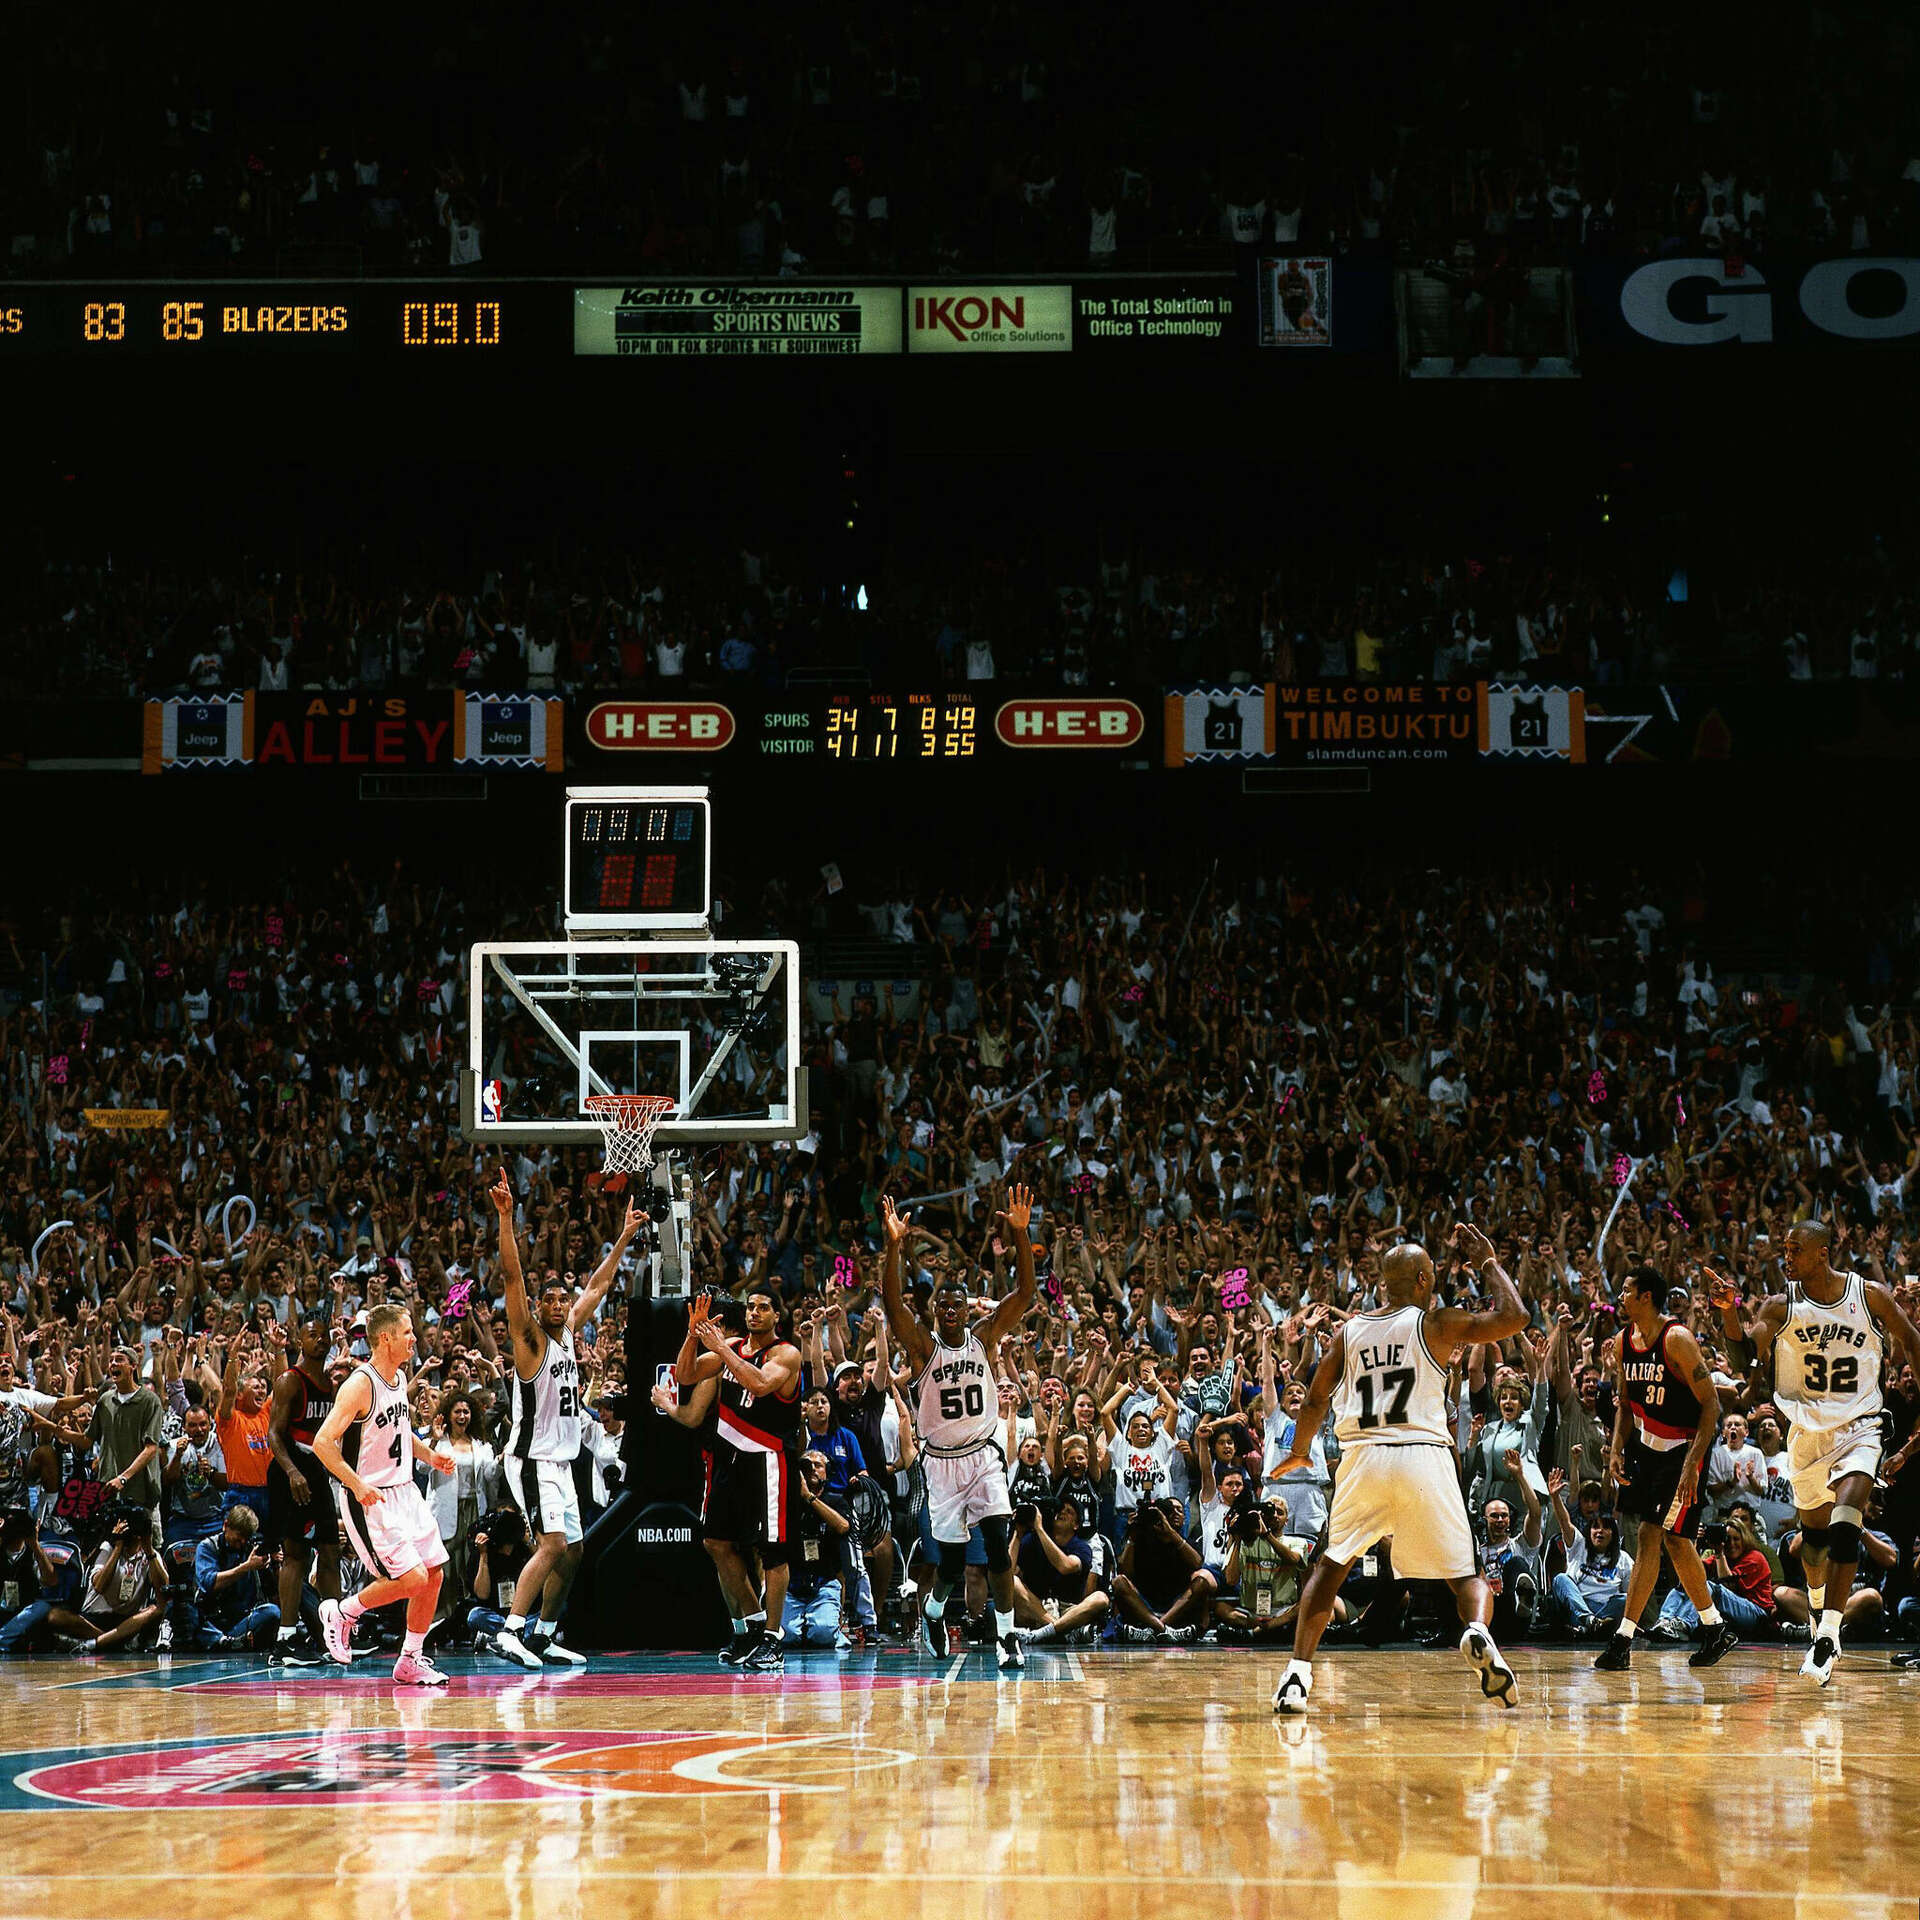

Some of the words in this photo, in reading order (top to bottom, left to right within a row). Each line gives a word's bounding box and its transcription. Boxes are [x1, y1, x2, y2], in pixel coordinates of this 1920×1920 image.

[621, 288, 694, 305] Keith
[700, 288, 855, 305] Olbermann
[1079, 299, 1106, 315] The
[1110, 298, 1150, 315] Total
[1153, 297, 1215, 315] Solution
[1218, 296, 1233, 314] in
[1621, 257, 1920, 345] GO
[0, 308, 23, 333] S
[85, 302, 125, 341] 83
[163, 302, 204, 341] 85
[223, 306, 348, 333] BLAZERS
[404, 302, 499, 345] 09.0
[712, 311, 783, 333] SPORTS
[787, 311, 841, 333] NEWS
[915, 296, 1025, 342] IKON
[1089, 319, 1133, 336] Office
[1137, 318, 1223, 337] Technology
[656, 339, 673, 353] ON
[678, 339, 700, 353] FOX
[705, 339, 754, 353] SPORTS
[759, 339, 782, 353] NET
[787, 338, 861, 353] SOUTHWEST
[971, 330, 1006, 342] Office
[1009, 330, 1065, 342] Solutions
[305, 696, 408, 717] AJ'S
[1280, 686, 1425, 704] WELCOME
[1435, 686, 1473, 704] TO
[764, 712, 811, 728] SPURS
[826, 708, 858, 732] 34
[883, 708, 897, 731] 7
[921, 707, 936, 730] 8
[945, 706, 976, 730] 49
[1213, 721, 1236, 741] 21
[1283, 710, 1473, 741] TIMBUKTU
[1519, 718, 1542, 737] 21
[184, 733, 219, 747] Jeep
[258, 719, 449, 765] ALLEY
[488, 731, 523, 745] Jeep
[760, 738, 816, 754] VISITOR
[827, 734, 858, 758] 41
[875, 734, 898, 757] 11
[921, 733, 936, 756] 3
[944, 733, 976, 756] 55
[1306, 748, 1449, 761] slamduncan.com
[1794, 1322, 1868, 1350] SPURS
[1359, 1344, 1404, 1371] ELIE
[931, 1359, 985, 1384] SPURS
[1803, 1352, 1859, 1393] 32
[559, 1385, 580, 1417] 21
[939, 1383, 984, 1420] 50
[1355, 1366, 1416, 1430] 17
[1645, 1384, 1665, 1406] 30
[306, 1400, 334, 1420] BLAZ
[375, 1402, 411, 1429] SPUR
[388, 1433, 402, 1468] 4
[637, 1527, 692, 1543] NBA.com
